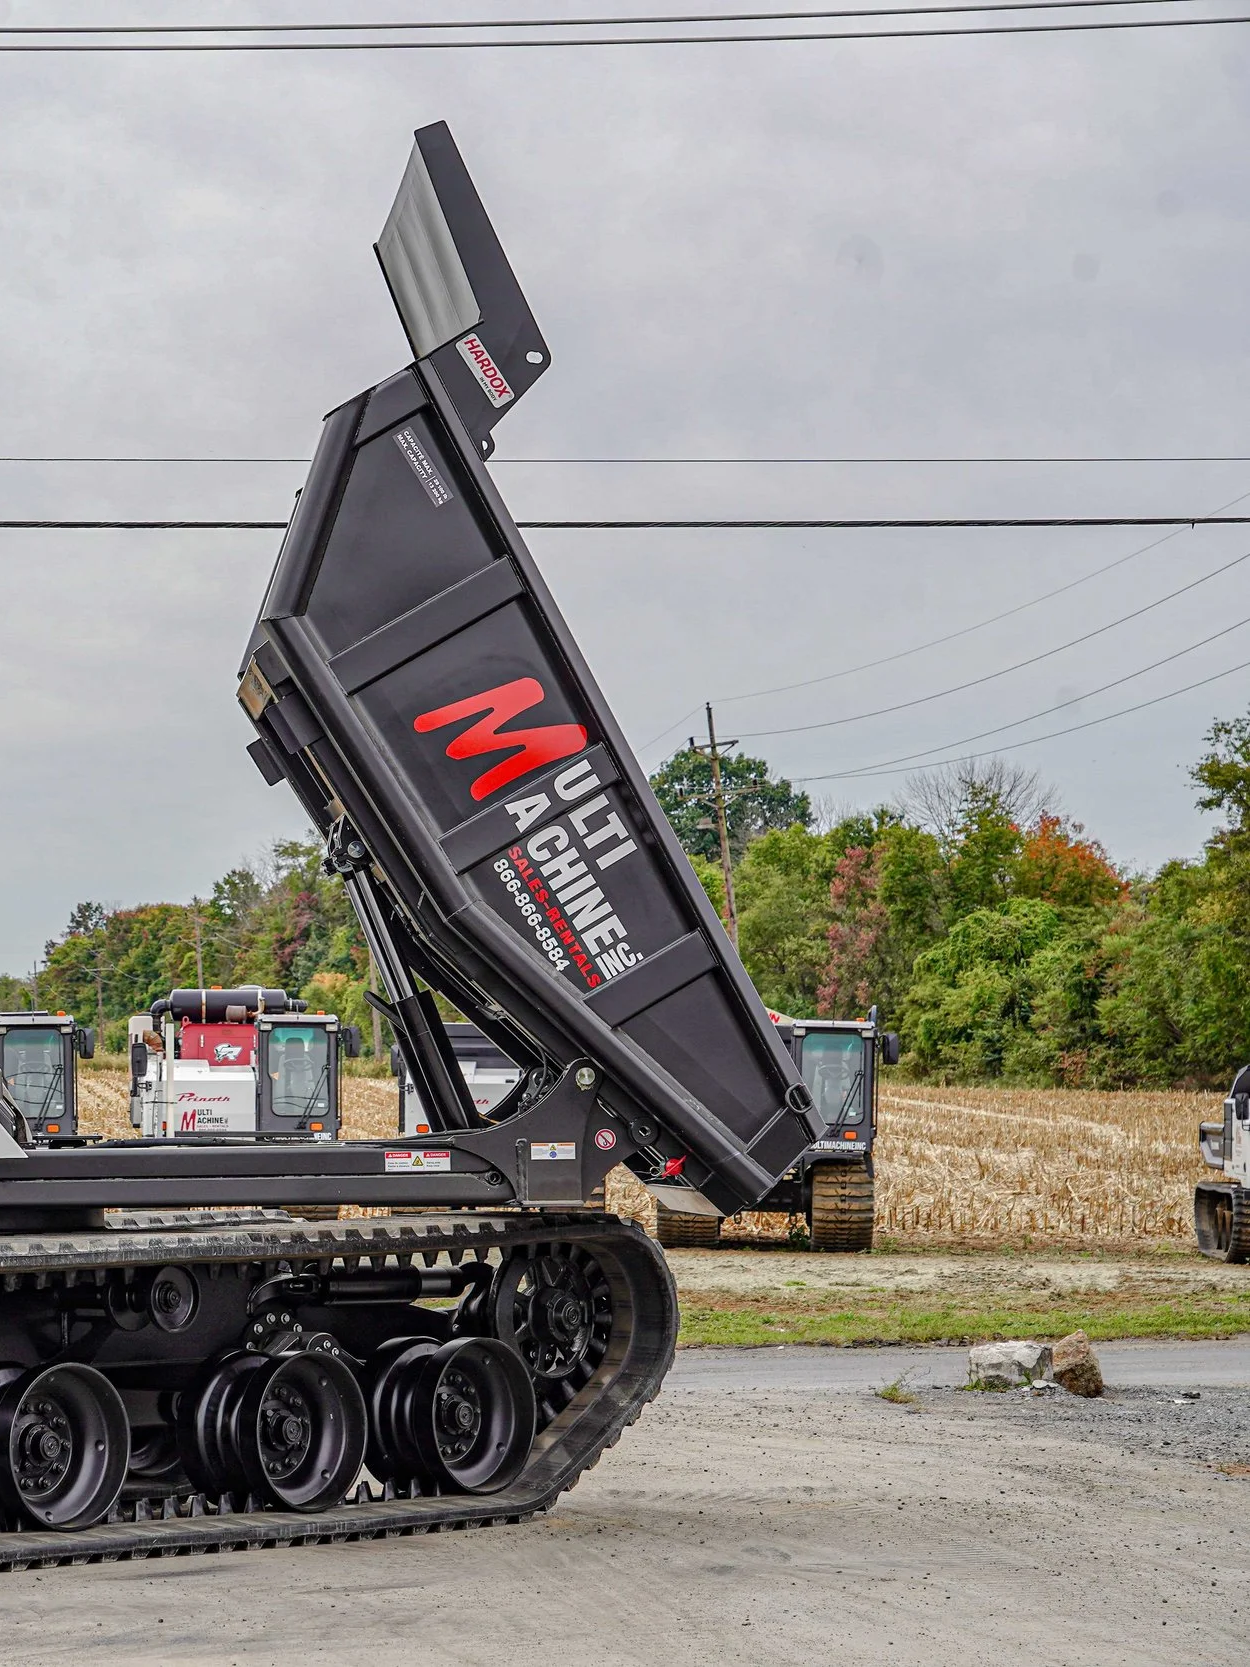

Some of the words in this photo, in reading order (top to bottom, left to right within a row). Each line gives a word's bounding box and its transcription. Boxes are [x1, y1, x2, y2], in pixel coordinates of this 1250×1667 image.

[464, 338, 511, 398] HARDOX
[397, 434, 409, 450] MAX.
[406, 449, 428, 479] CAPACITY
[421, 460, 433, 475] MAX.
[493, 858, 570, 971] 866-866-8584
[176, 1092, 230, 1102] Prinoth
[810, 1140, 867, 1150] ULTIMACHINEINC
